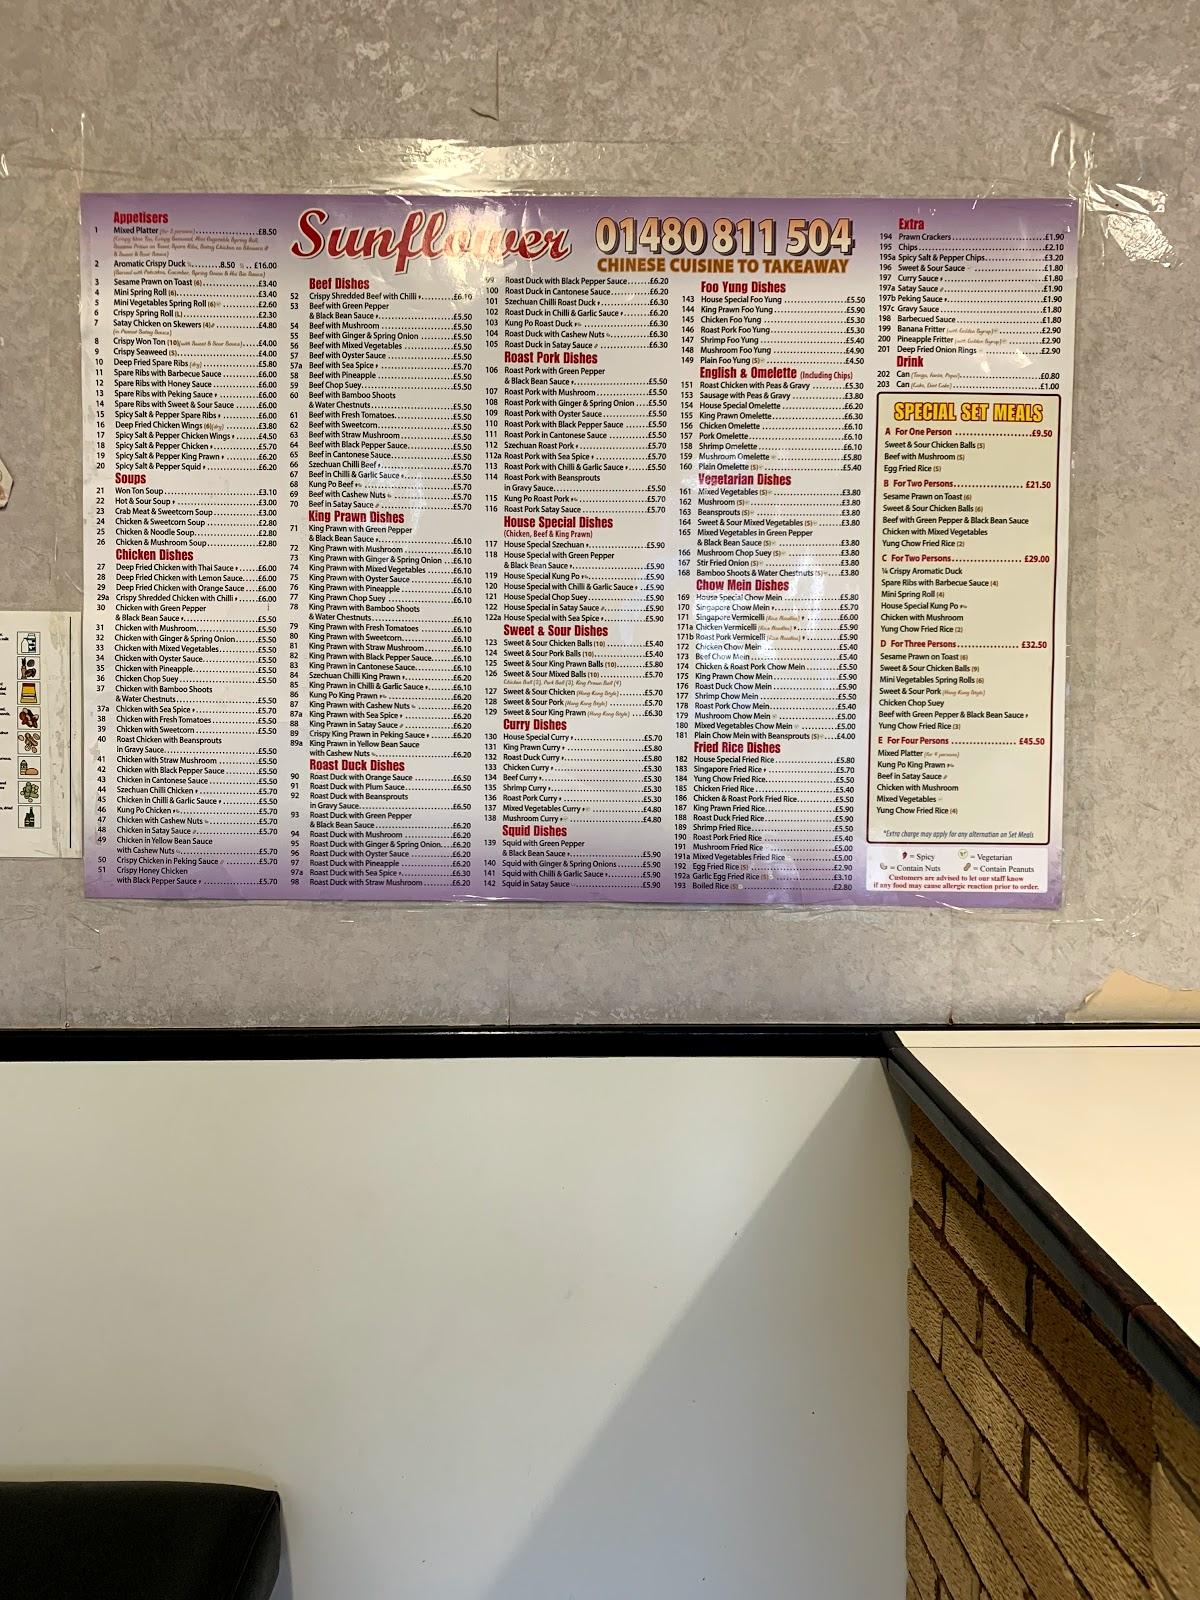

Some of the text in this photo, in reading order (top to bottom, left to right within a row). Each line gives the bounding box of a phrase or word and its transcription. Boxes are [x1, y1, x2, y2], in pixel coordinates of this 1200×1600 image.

[113, 211, 168, 224] Appetisers
[899, 218, 924, 230] Extra
[290, 210, 573, 274] Sunflower
[595, 217, 855, 256] 01480 811 504
[898, 244, 918, 252] Chips
[597, 257, 849, 274] CHINESE CUISINE TO TAKEAWAY
[309, 278, 369, 289] Beef Dishes
[701, 281, 786, 293] Foo Yung Dishes
[701, 306, 717, 314] King
[756, 307, 773, 315] Yung
[504, 352, 597, 364] Roast Pork Dishes
[897, 356, 923, 367] Drink
[700, 367, 852, 380] English & Omelette (Including Chips)
[115, 401, 134, 409] Spare
[894, 402, 1043, 422] SPECIAL SET MEALS
[115, 473, 146, 484] Soups
[698, 473, 791, 486] Vegetarian Dishes
[309, 510, 404, 523] King Prawn Dishes
[504, 516, 613, 529] House Special Dishes
[504, 530, 532, 538] (Chicken,
[556, 531, 569, 539] King
[928, 528, 949, 536] Mixed
[950, 529, 988, 537] Vegetables
[116, 549, 194, 561] Chicken Dishes
[891, 554, 903, 562] For
[905, 554, 920, 562] Two
[309, 565, 324, 573] King
[388, 566, 426, 574] Vegetables
[696, 579, 789, 591] Chow Mein Dishes
[503, 624, 608, 636] Sweet & Sour Dishes
[905, 640, 926, 648] Three
[1022, 641, 1047, 649] £32.50
[503, 719, 567, 731] Curry Dishes
[694, 742, 781, 753] Fried Rice Dishes
[310, 759, 405, 771] Roast Duck Dishes
[502, 825, 567, 837] Squid Dishes
[933, 831, 947, 839] apply
[917, 853, 935, 861] Spicy
[977, 854, 1012, 862] Vegetarian
[941, 883, 966, 891] allergic
[994, 883, 1011, 891] prior
